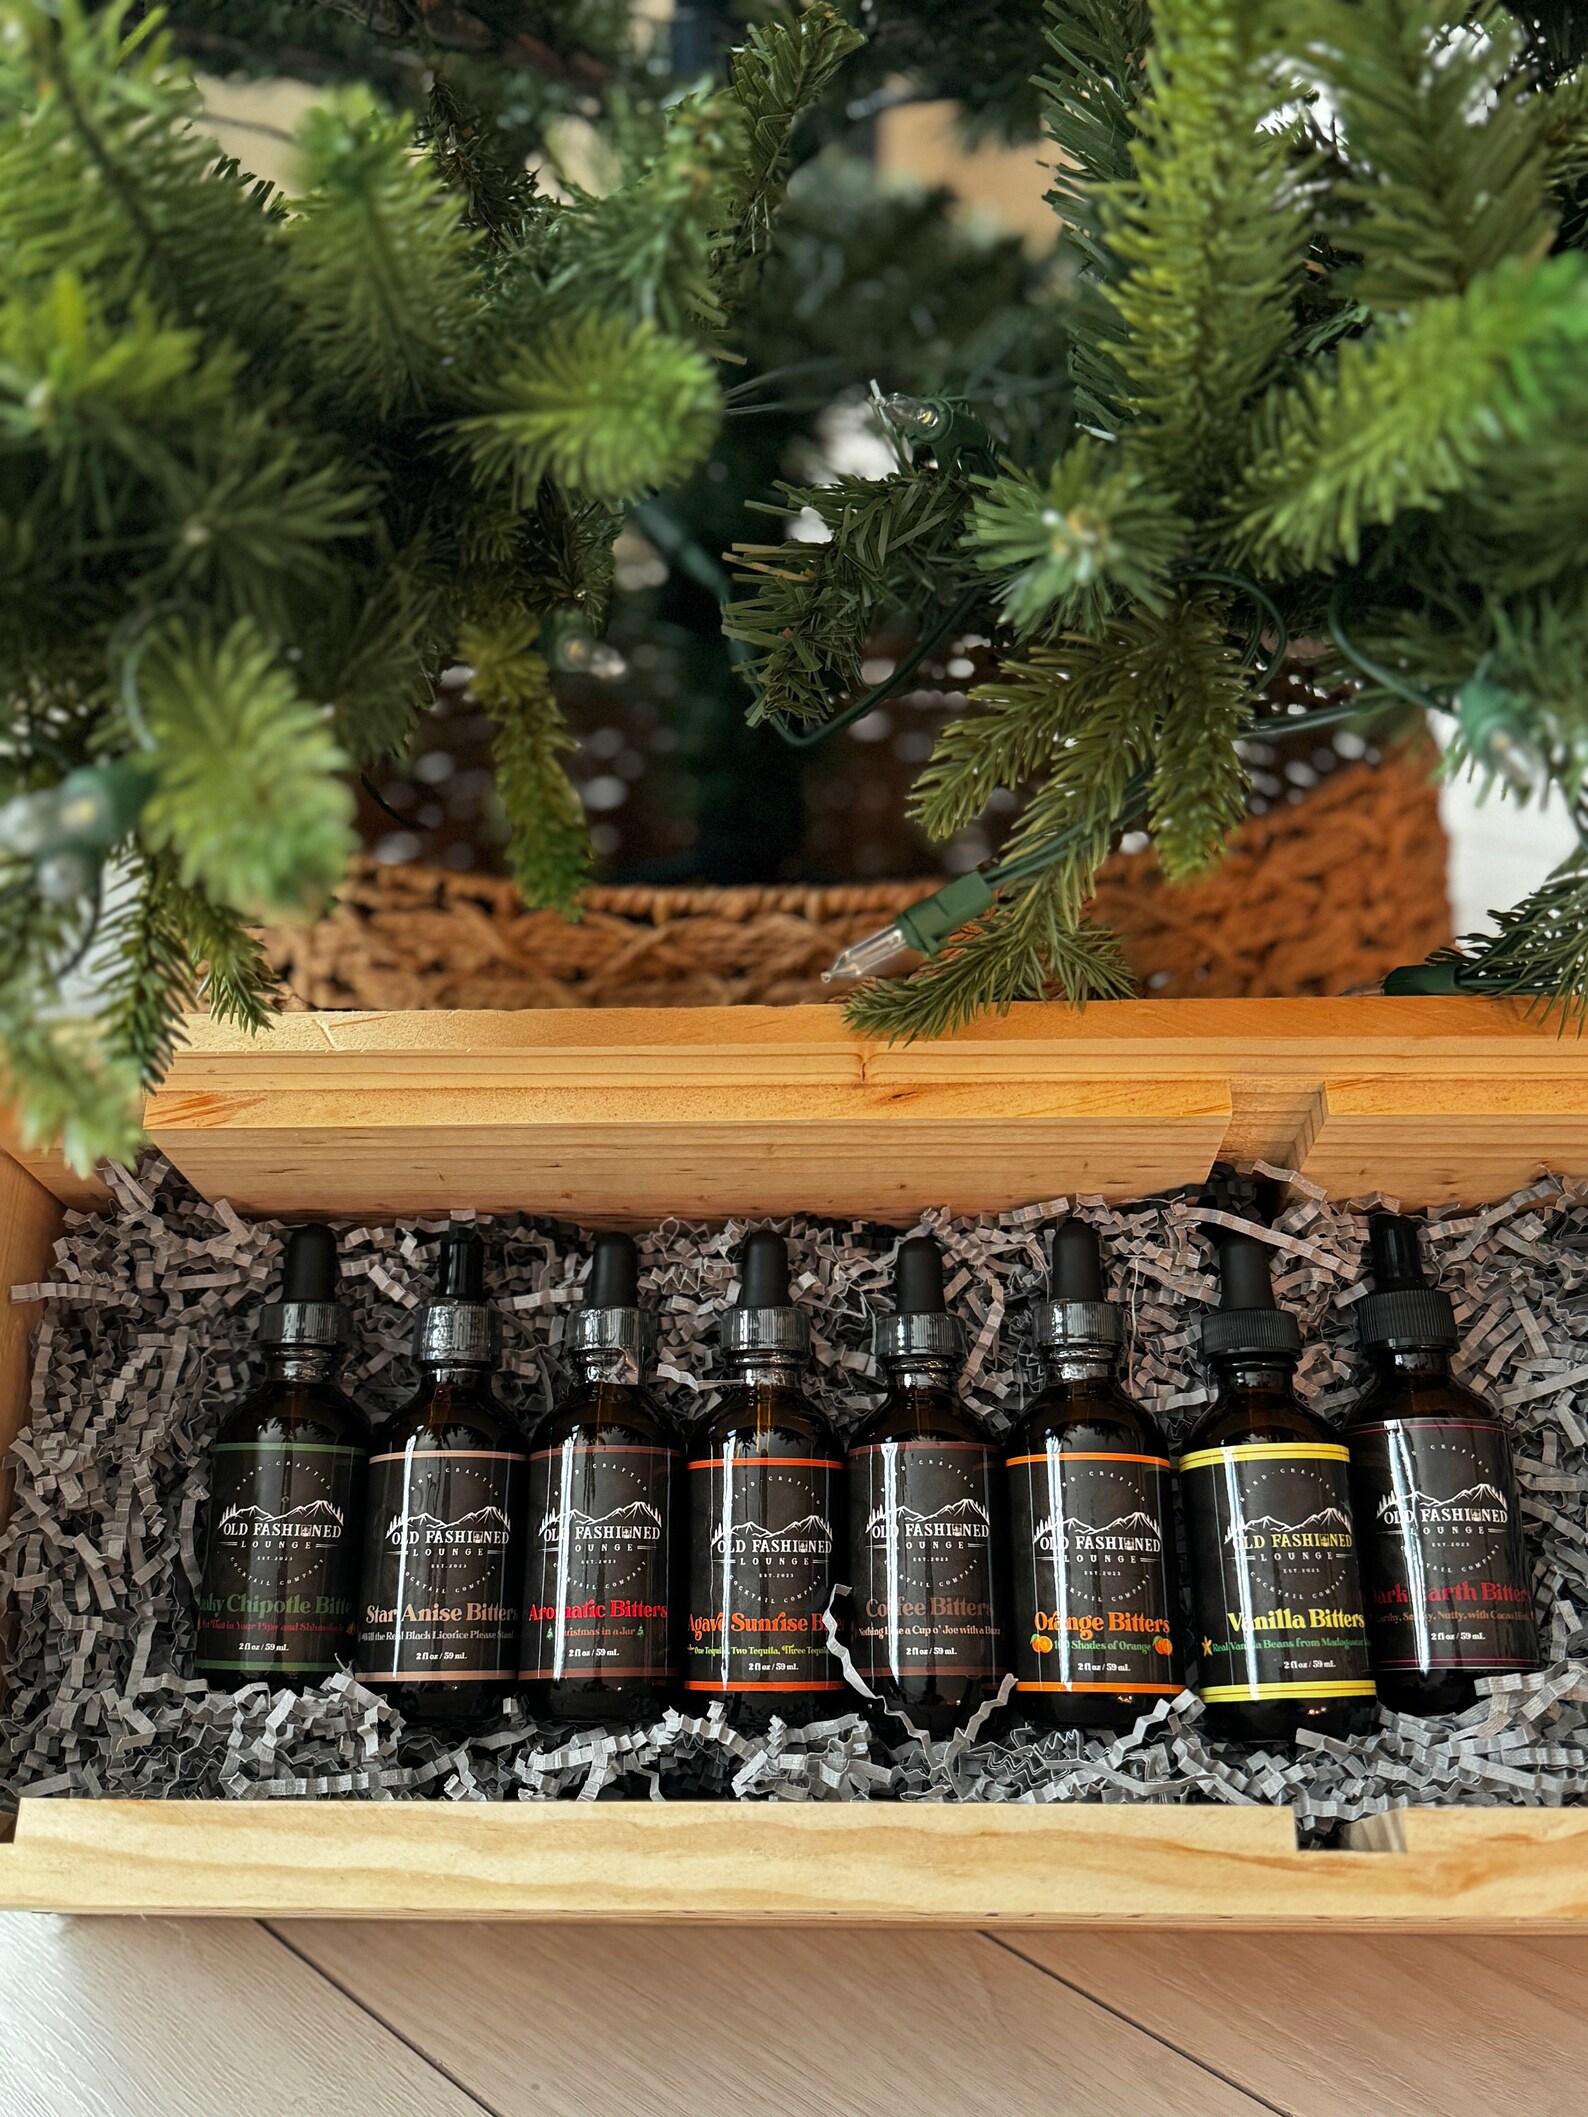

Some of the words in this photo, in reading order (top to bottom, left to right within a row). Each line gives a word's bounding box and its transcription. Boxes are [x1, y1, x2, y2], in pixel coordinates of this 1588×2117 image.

[1384, 1510, 1414, 1525] OLD
[224, 1523, 248, 1536] OLD
[544, 1526, 567, 1542] OL
[1410, 1526, 1485, 1535] LOUNGE
[240, 1540, 312, 1549] LOUNGE
[392, 1530, 420, 1545] OLD
[413, 1549, 484, 1557] LOUNGE
[575, 1544, 633, 1552] OUNGE
[718, 1540, 746, 1554] OLD
[1065, 1555, 1136, 1563] LOUNGE
[1261, 1552, 1333, 1561] LOUNGE
[405, 1571, 446, 1594] OCKTAIL
[1372, 1584, 1408, 1604] ark
[1415, 1580, 1477, 1601] arth
[226, 1594, 312, 1619] Chipotle
[366, 1604, 397, 1624] Star
[401, 1603, 462, 1622] Anise
[610, 1600, 668, 1618] Bitters
[866, 1596, 926, 1618] Cofee
[930, 1597, 992, 1616] Bitters
[730, 1612, 808, 1632] Sunrise
[1308, 1608, 1365, 1628] Bitters
[602, 1627, 610, 1635] in
[620, 1627, 635, 1636] Jar
[912, 1625, 931, 1636] Cup
[943, 1626, 959, 1634] Joe
[959, 1625, 979, 1634] with
[1034, 1612, 1104, 1640] Orange
[1108, 1612, 1170, 1633] Bitters
[386, 1632, 404, 1640] Rel
[406, 1631, 430, 1640] Black
[432, 1630, 468, 1640] Licorice
[470, 1631, 496, 1639] Please
[1071, 1640, 1106, 1650] Shades
[1108, 1640, 1118, 1650] of
[1120, 1641, 1151, 1655] Orange
[1263, 1639, 1294, 1649] Beans
[1296, 1638, 1319, 1648] from
[575, 1649, 581, 1657] fl
[1284, 1661, 1290, 1669] 2
[1313, 1660, 1322, 1668] 59
